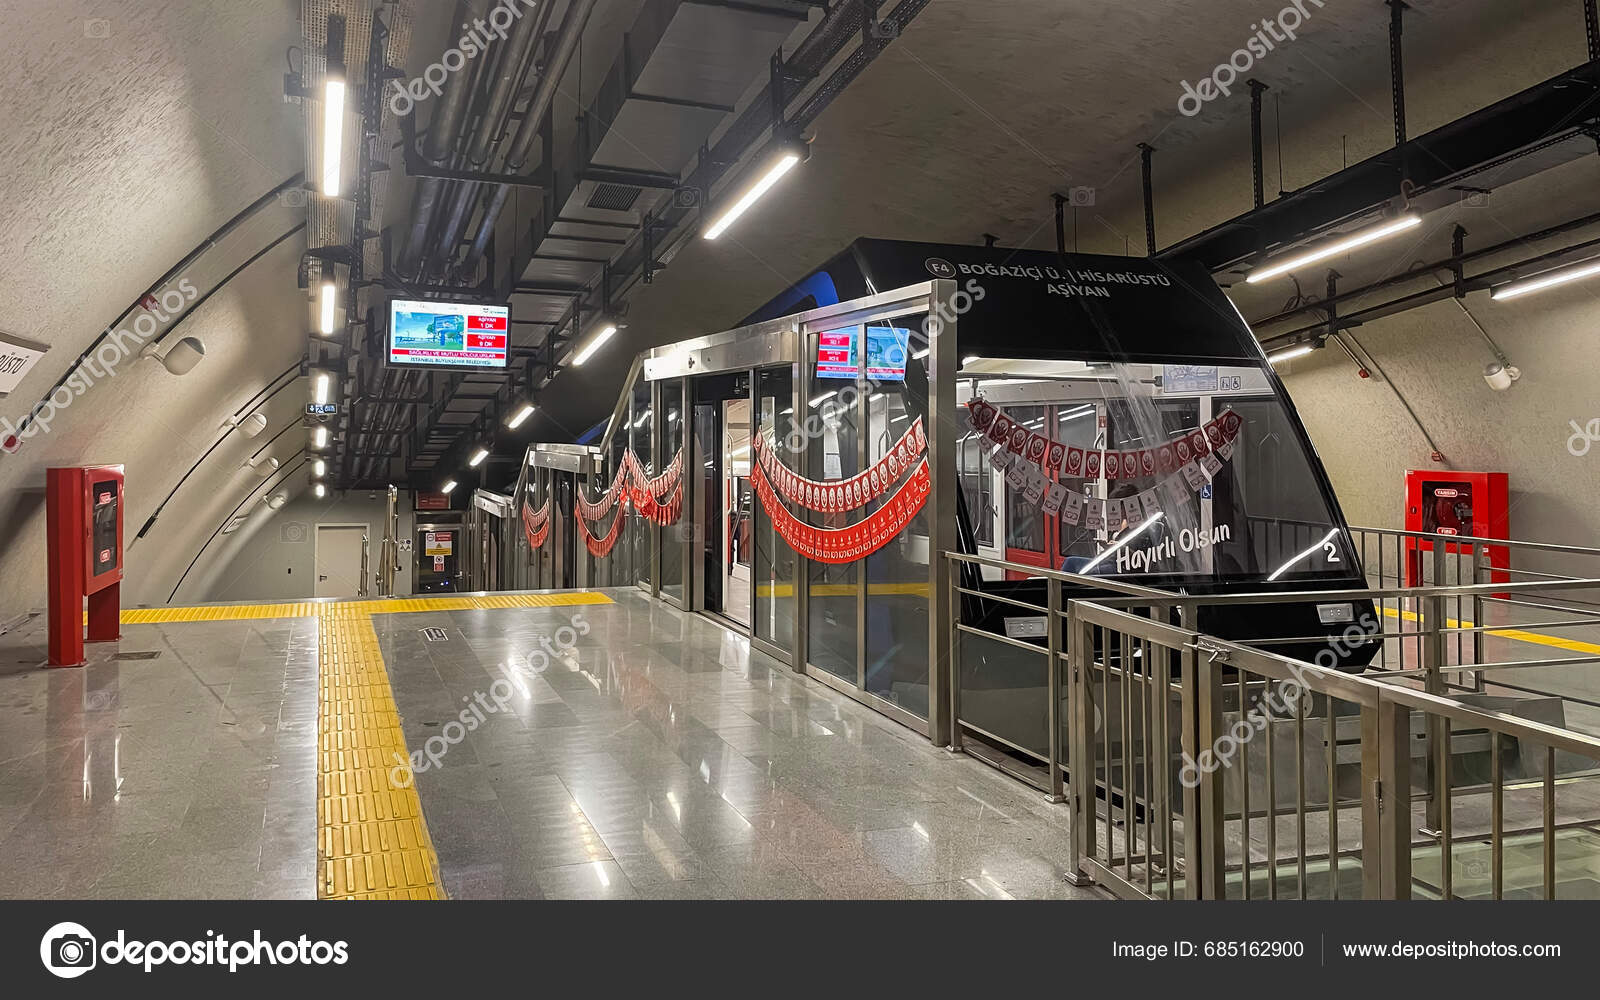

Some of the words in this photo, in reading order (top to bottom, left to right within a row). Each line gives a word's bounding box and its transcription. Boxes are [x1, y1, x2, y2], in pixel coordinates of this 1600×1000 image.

[931, 263, 950, 273] F4
[958, 262, 1044, 281] BOĞAZİÇİ
[1077, 269, 1171, 287] HİSARÜSTÜ
[1047, 282, 1111, 298] AŞİYAN
[1116, 536, 1175, 573] Hayırlı
[1179, 523, 1231, 553] Olsun
[1323, 542, 1340, 562] 2
